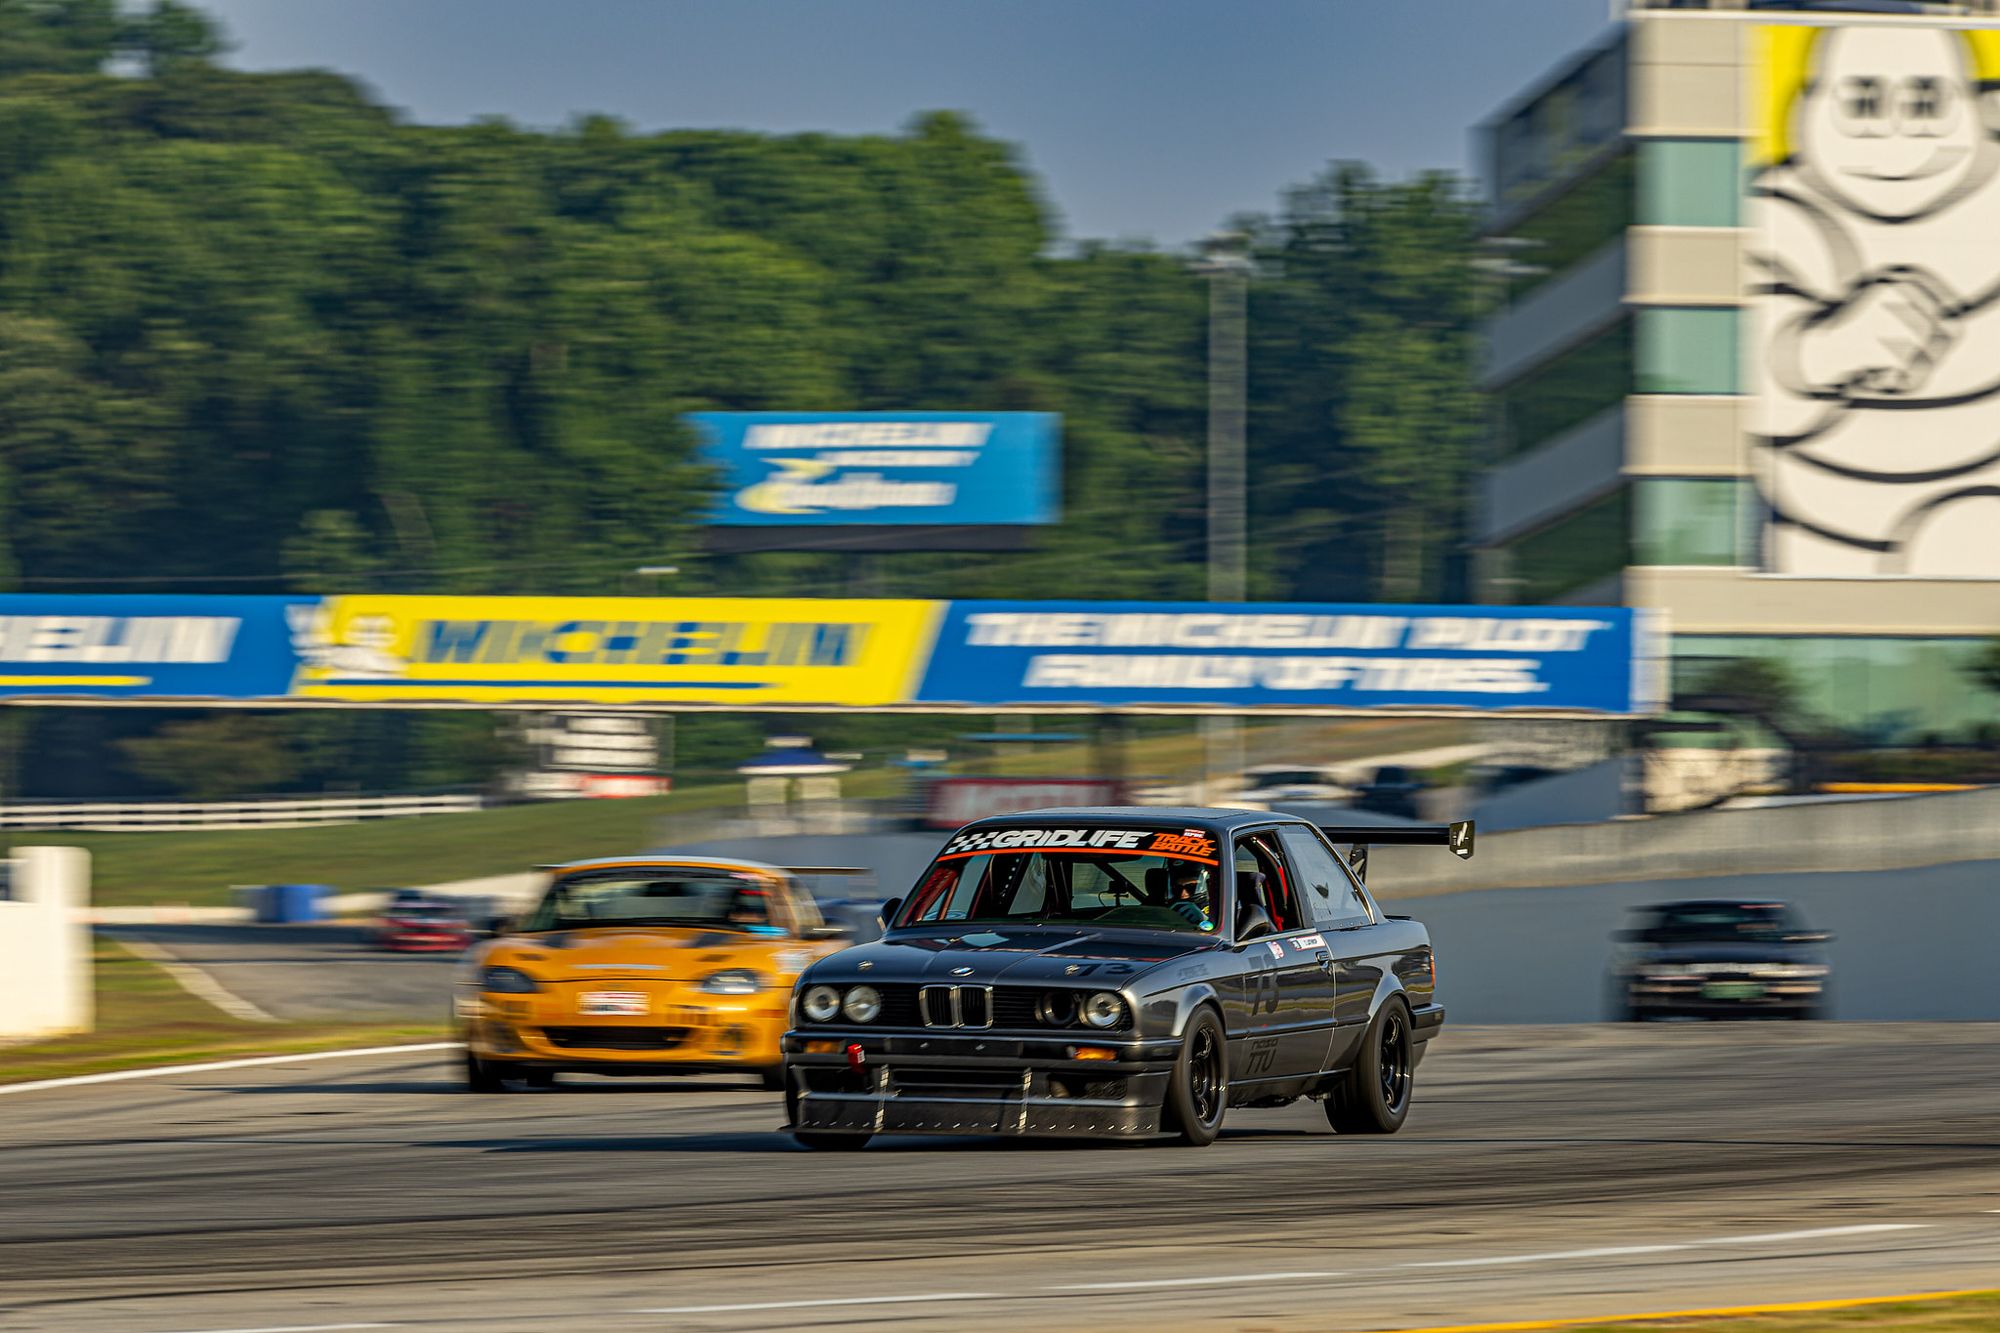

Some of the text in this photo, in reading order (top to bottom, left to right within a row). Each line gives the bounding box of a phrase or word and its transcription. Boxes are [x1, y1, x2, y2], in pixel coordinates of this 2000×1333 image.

[0, 615, 243, 663] ELIN
[964, 613, 1614, 652] THE MICHELIN PILOT
[412, 620, 878, 667] MICHELIN
[992, 829, 1153, 849] GRIDLIFE
[1149, 841, 1217, 856] BATTLE
[1154, 833, 1216, 848] TRACK
[1078, 962, 1136, 977] 73
